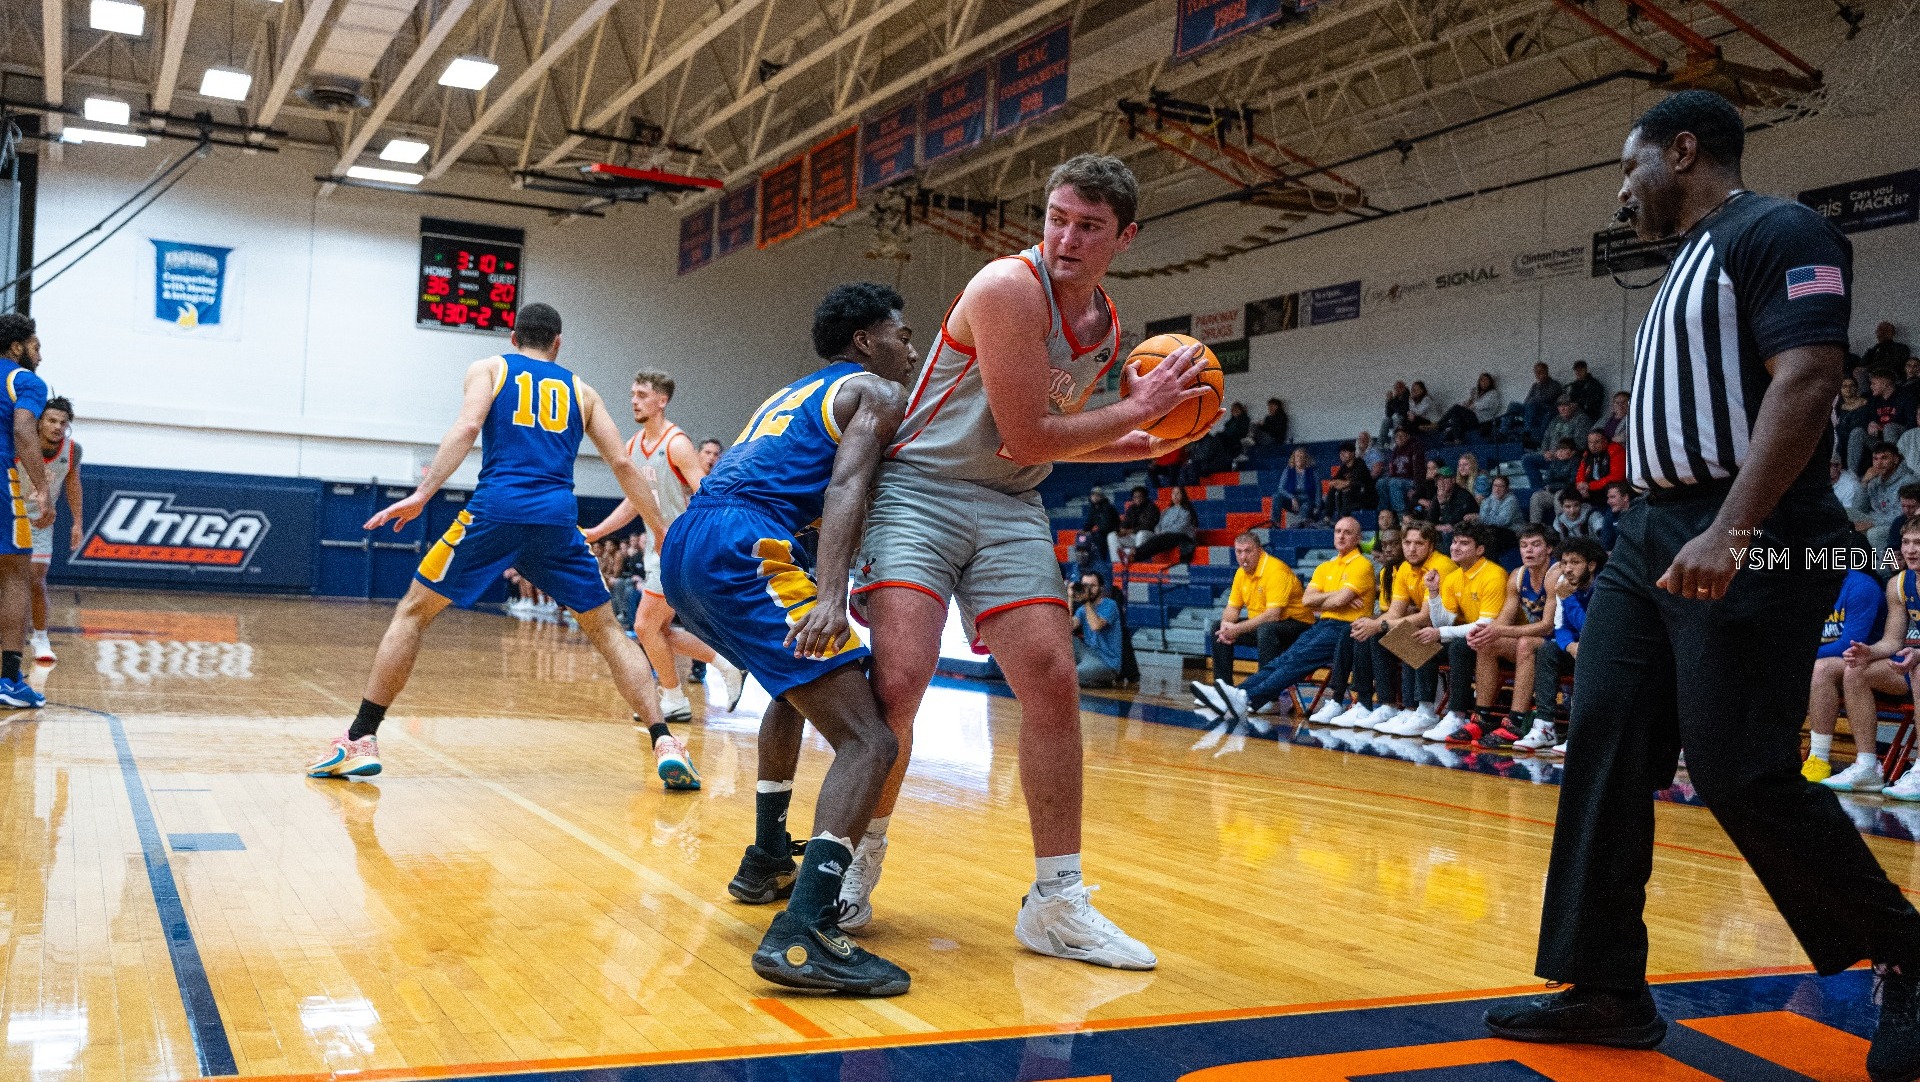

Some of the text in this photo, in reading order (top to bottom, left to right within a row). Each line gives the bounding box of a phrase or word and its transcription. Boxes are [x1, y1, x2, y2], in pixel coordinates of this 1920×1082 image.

[1849, 185, 1894, 201] Can you
[1852, 194, 1894, 213] HACK
[162, 272, 218, 287] Competing
[422, 265, 452, 279] HOME
[487, 274, 518, 285] GUEST
[1435, 265, 1500, 289] SIGNAL
[162, 281, 217, 295] with Honor
[489, 282, 516, 303] 20
[172, 291, 216, 305] Integrity
[501, 310, 515, 328] 4
[1195, 309, 1239, 328] PARKWAY
[512, 371, 570, 433] 10
[101, 498, 262, 549] UTICA
